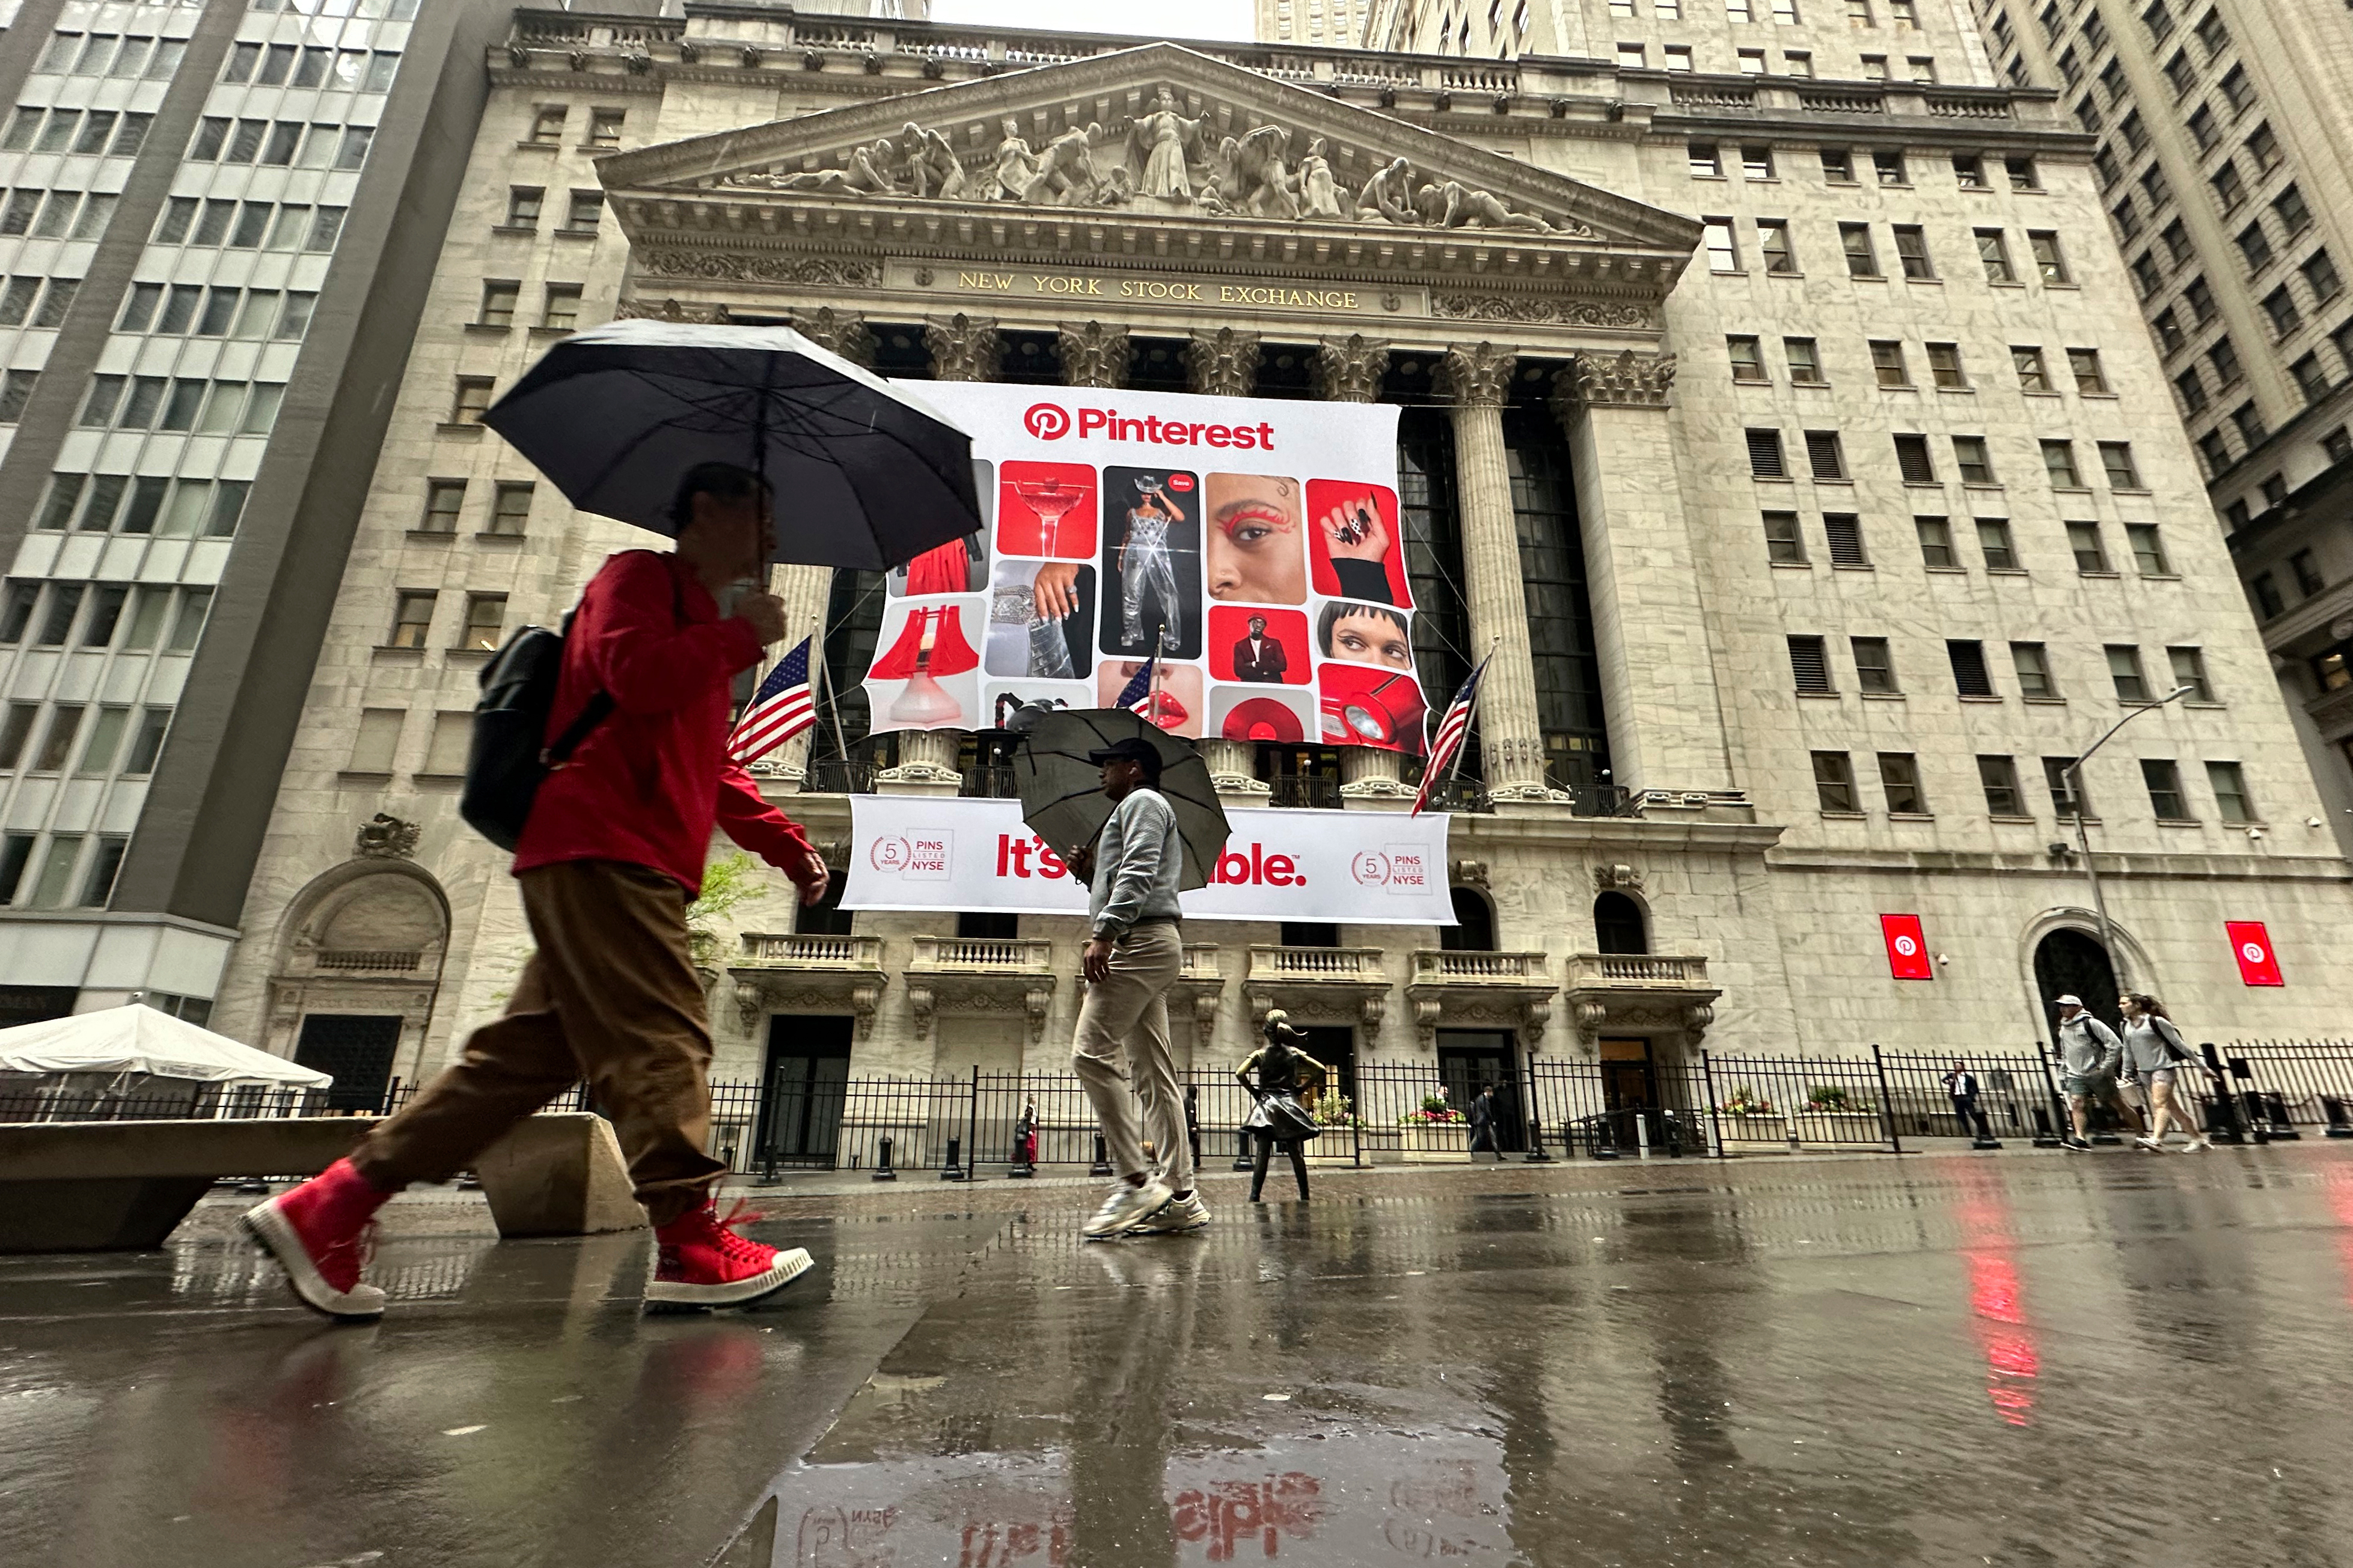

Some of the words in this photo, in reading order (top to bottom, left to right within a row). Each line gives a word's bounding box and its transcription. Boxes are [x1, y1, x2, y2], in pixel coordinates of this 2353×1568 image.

[958, 272, 1015, 290] NEW
[1032, 276, 1104, 295] YORK
[1120, 281, 1203, 300] STOCK
[1220, 286, 1359, 309] EXCHANGE
[1078, 407, 1274, 451] Pinterest
[884, 843, 896, 859] 5
[916, 841, 943, 850] PINS
[911, 861, 944, 870] NYSE
[996, 834, 1068, 879] It's
[1208, 843, 1307, 887] ble.
[1365, 858, 1377, 874] 5
[1395, 855, 1421, 865] PINS
[1393, 875, 1424, 885] NYSE
